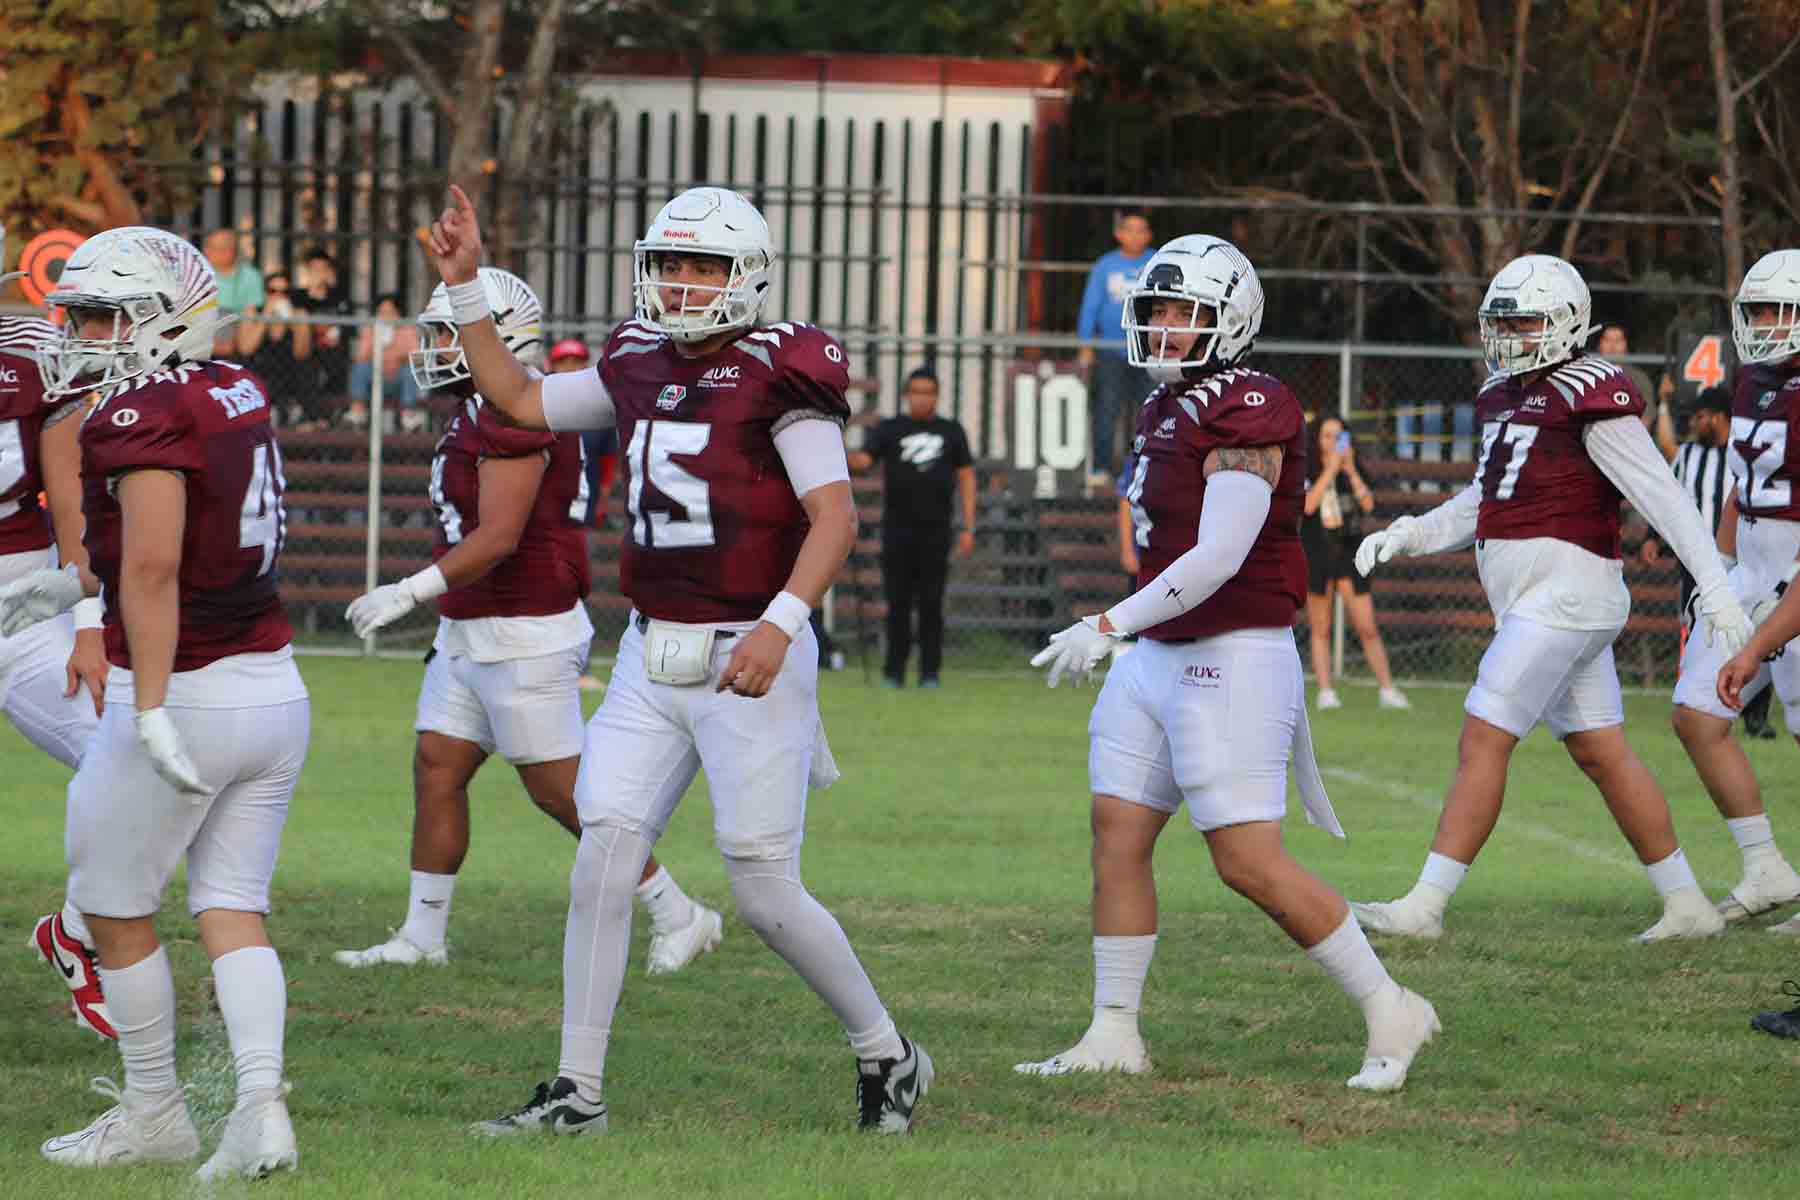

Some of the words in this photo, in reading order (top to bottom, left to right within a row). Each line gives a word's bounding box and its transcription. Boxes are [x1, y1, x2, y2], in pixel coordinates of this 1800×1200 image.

[1684, 336, 1725, 390] 4
[1014, 373, 1088, 470] 10
[1472, 421, 1540, 500] 77
[626, 419, 716, 548] 15
